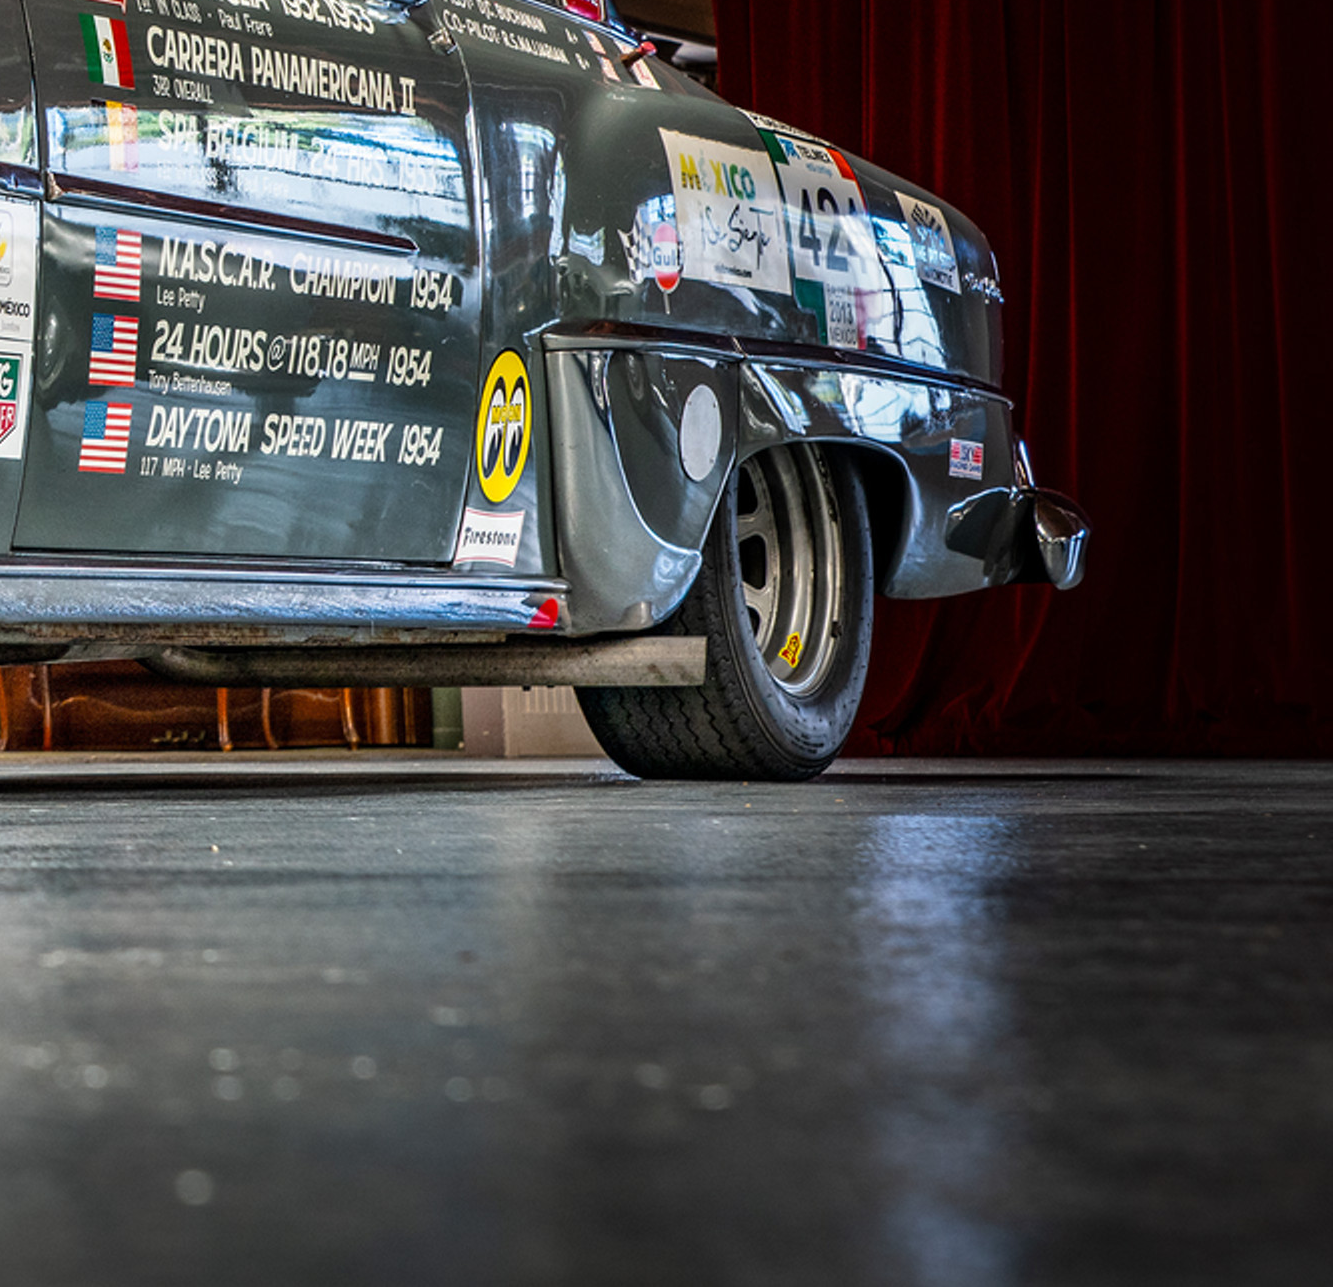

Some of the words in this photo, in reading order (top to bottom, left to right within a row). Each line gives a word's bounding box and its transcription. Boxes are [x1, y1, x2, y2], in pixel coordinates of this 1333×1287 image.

[218, 8, 241, 31] Paul
[146, 25, 245, 82] CARRERA
[250, 45, 396, 113] PANAMERICANA
[399, 76, 416, 115] II
[173, 78, 215, 104] OVERALL
[157, 110, 199, 156] SPA
[208, 117, 299, 173] BELGIUM
[158, 235, 276, 291] N.A.S.C.A.R.
[289, 252, 397, 305] CHAMPION
[410, 268, 453, 312] 1954
[156, 285, 176, 306] Lee
[178, 287, 206, 314] Petty
[151, 319, 185, 362] 24
[189, 324, 269, 372] HOURS
[349, 342, 381, 370] MPH
[385, 346, 433, 387] 1954
[148, 369, 171, 395] Tony
[173, 371, 232, 396] Bettenhausen
[145, 405, 252, 453] DAYTONA
[260, 413, 326, 458] SPEED
[331, 418, 394, 463] WEEK
[396, 424, 445, 466] 1954
[140, 456, 159, 476] 117
[161, 457, 186, 477] MPH
[193, 459, 212, 480] Lee
[215, 460, 244, 485] Petty
[463, 526, 517, 548] Firestone
